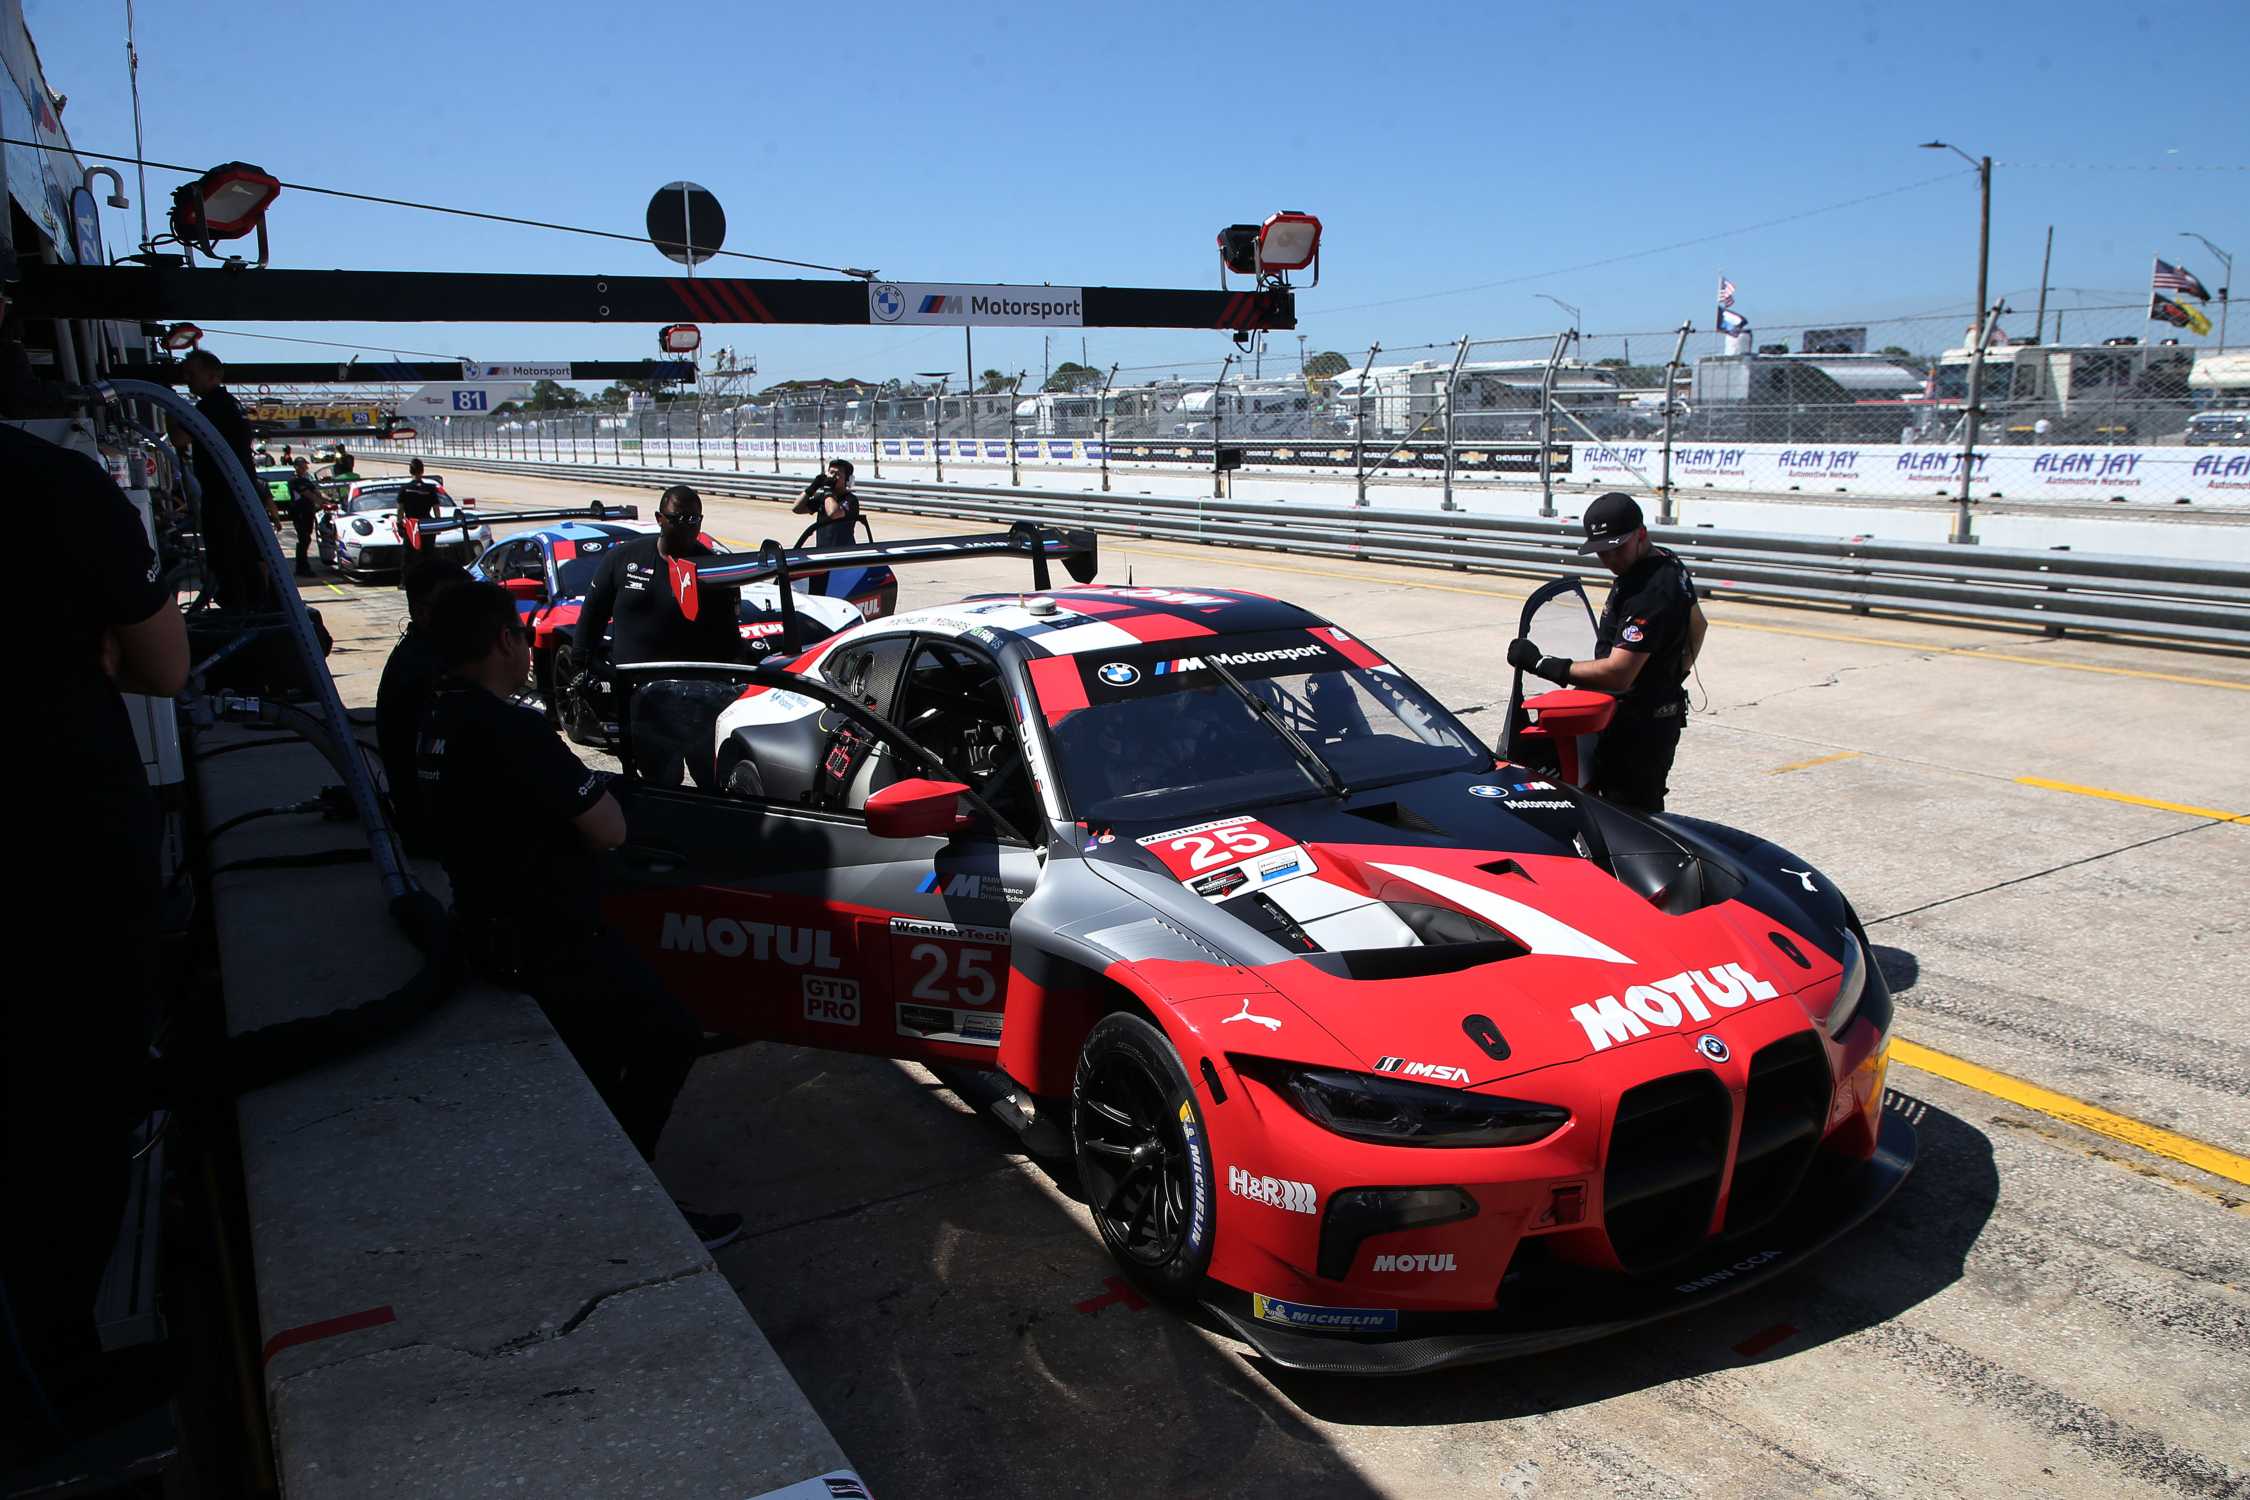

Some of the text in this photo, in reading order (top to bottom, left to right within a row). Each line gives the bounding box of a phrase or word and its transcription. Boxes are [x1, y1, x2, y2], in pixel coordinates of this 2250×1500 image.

[971, 296, 1080, 319] Motorsport
[513, 367, 570, 377] Motorsport
[458, 391, 482, 410] 81
[1495, 454, 1533, 462] CHEVROLET
[1676, 449, 1745, 467] ALAN JAY
[1778, 450, 1859, 470] ALAN JAY
[1897, 452, 1991, 474] ALAN JY
[2033, 453, 2142, 477] ALAN JAY
[2045, 476, 2141, 487] Automotive Network
[856, 594, 880, 615] TUL
[1213, 644, 1327, 667] Motorsport
[1504, 800, 1575, 810] Motorsport
[1140, 816, 1250, 843] WeatherTech
[1170, 826, 1270, 871] 25
[660, 912, 840, 970] MOTUL
[895, 920, 1005, 942] WeatherTech
[911, 943, 996, 1006] 25
[806, 978, 857, 1001] GTD
[806, 999, 856, 1021] PRO
[1569, 961, 1780, 1051] MOTUL
[1403, 1061, 1470, 1084] IMSA
[1190, 1144, 1208, 1246] MICHELIN
[1228, 1166, 1290, 1210] H&R
[1372, 1254, 1457, 1273] MOTUL
[1674, 1250, 1784, 1293] BMW CCA
[1292, 1311, 1384, 1326] MICHELIN
